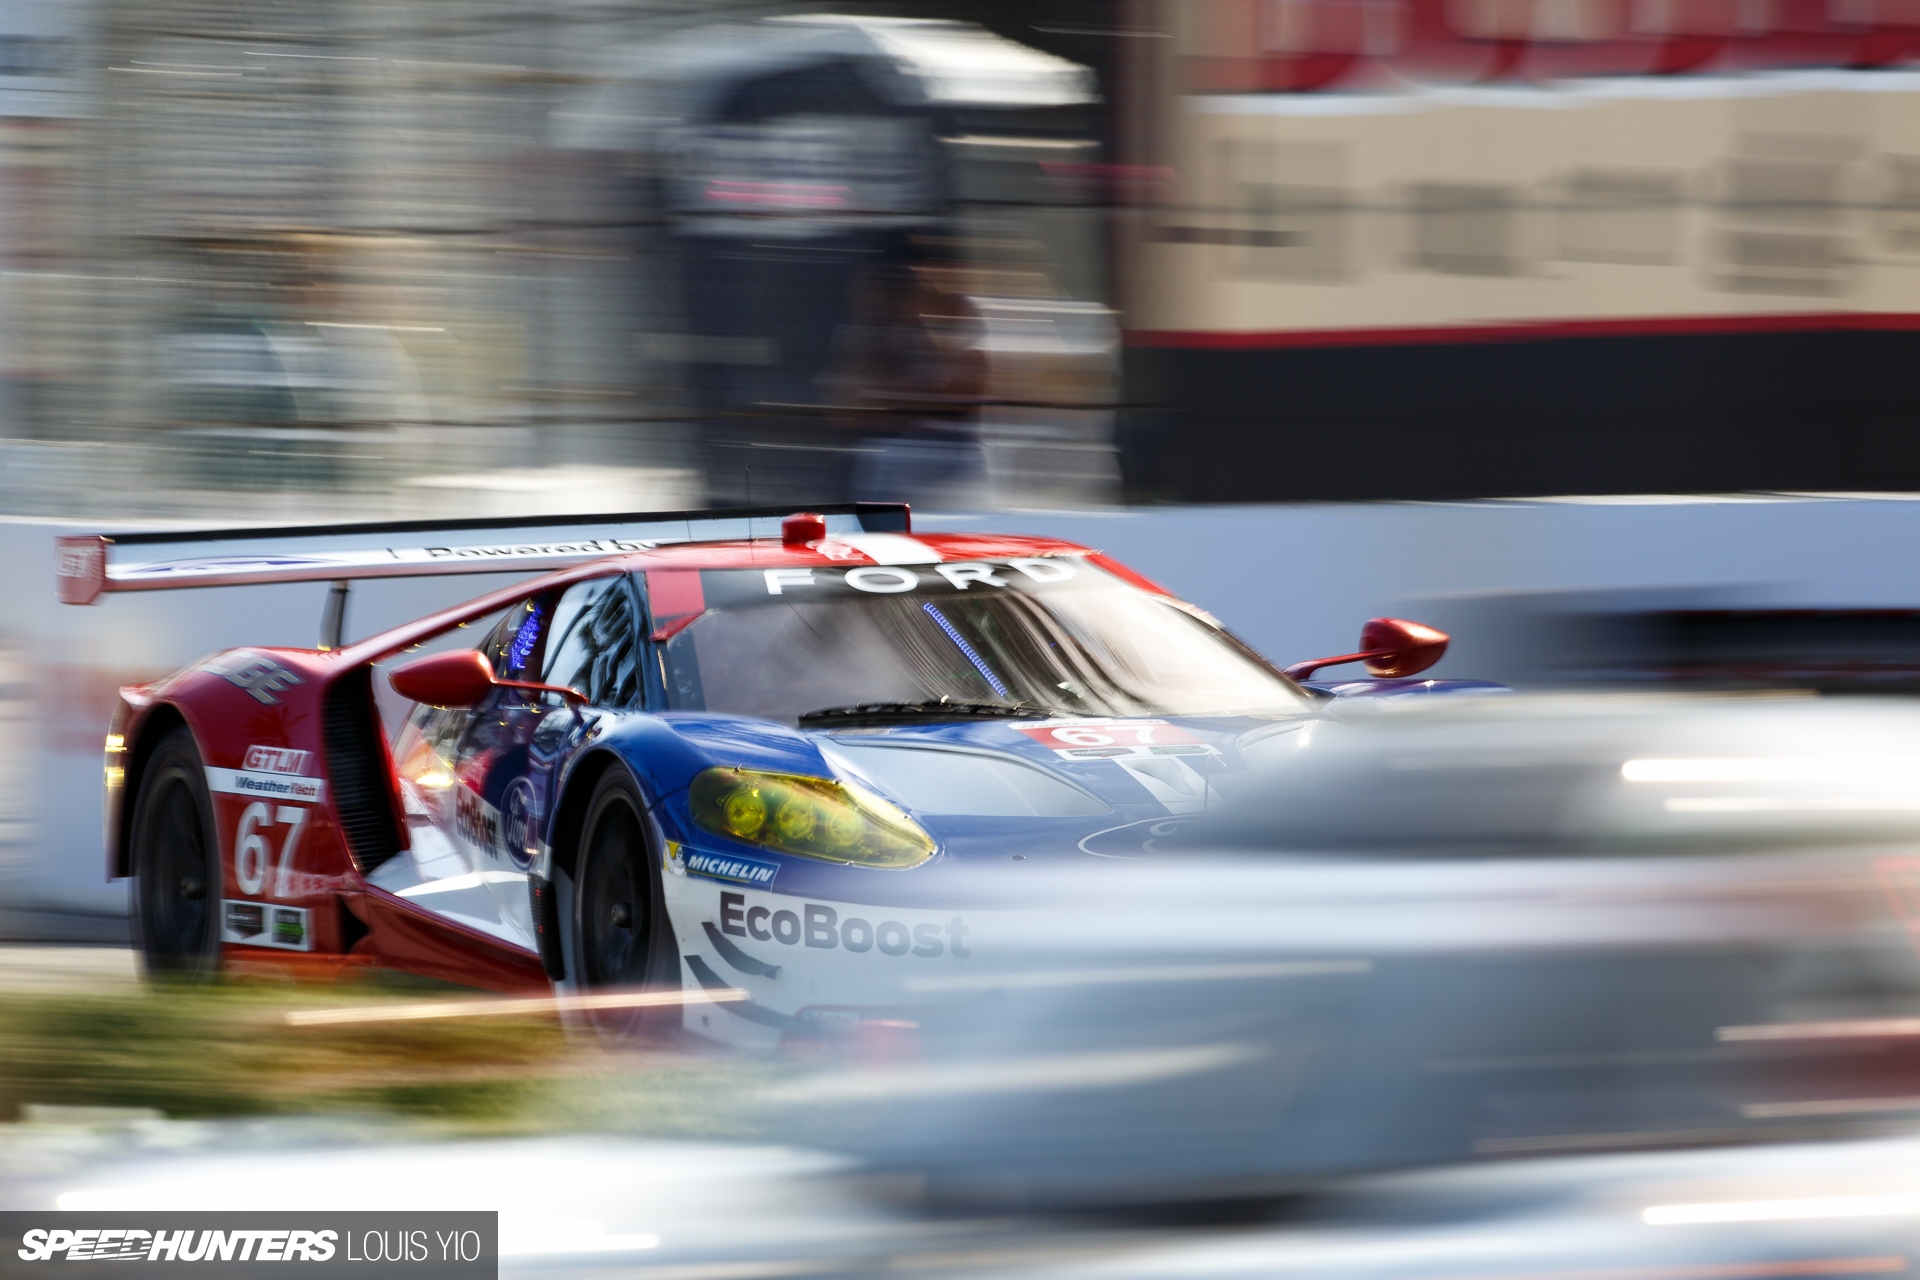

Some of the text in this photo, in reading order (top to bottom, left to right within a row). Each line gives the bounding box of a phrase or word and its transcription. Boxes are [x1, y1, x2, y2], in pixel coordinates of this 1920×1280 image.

[422, 539, 604, 559] Powered
[763, 556, 1079, 596] FORD
[1050, 725, 1157, 747] 67
[244, 746, 308, 774] GTLM
[234, 775, 318, 797] WeatherTech
[234, 801, 310, 898] 67
[687, 854, 774, 883] MICHELIN
[720, 890, 970, 959] EcoBoost
